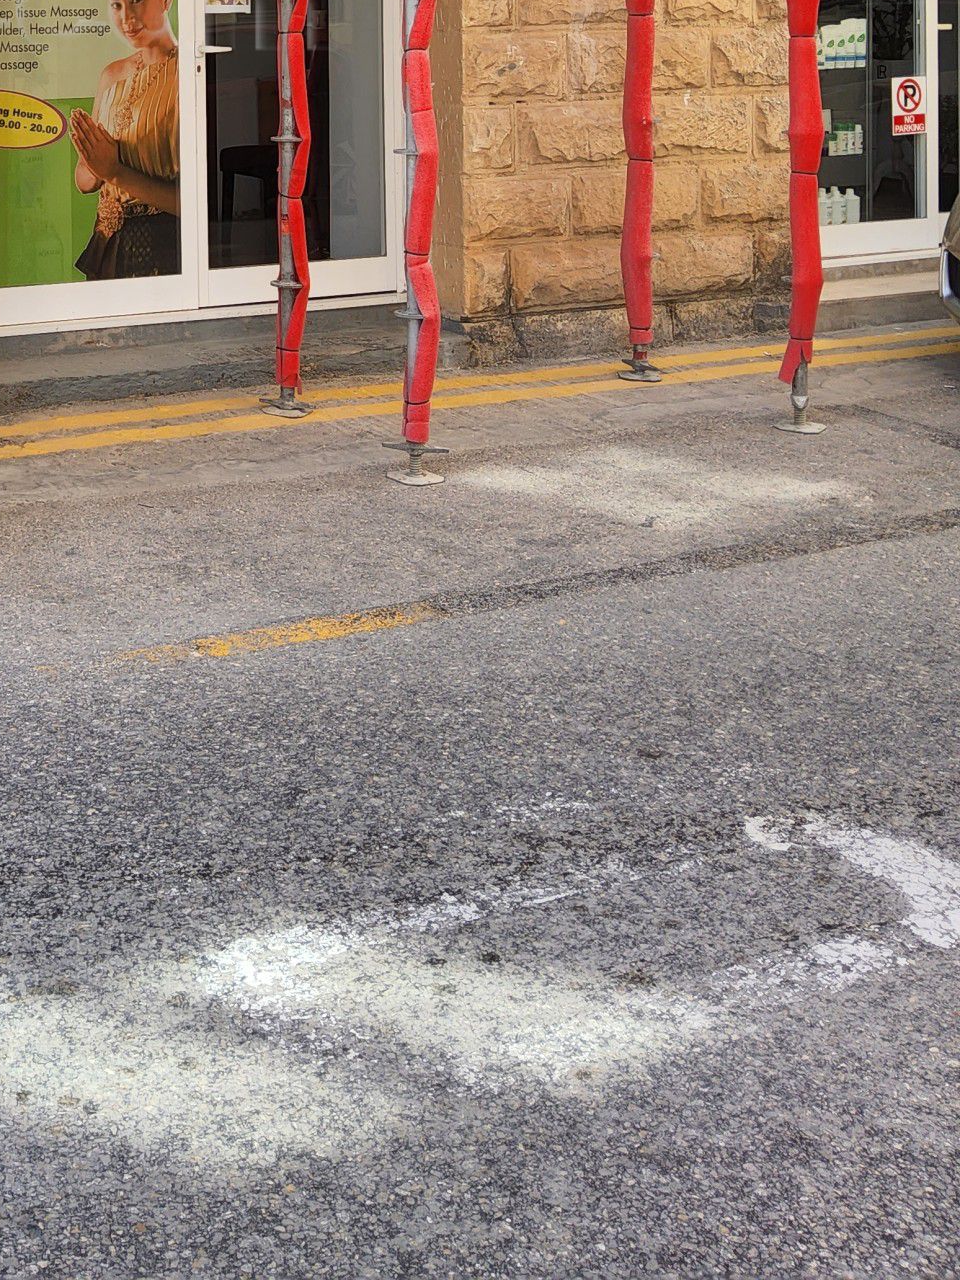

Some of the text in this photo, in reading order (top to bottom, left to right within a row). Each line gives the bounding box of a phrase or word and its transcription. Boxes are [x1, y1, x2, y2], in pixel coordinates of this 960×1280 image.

[17, 7, 47, 19] tissue
[50, 5, 99, 19] Massage
[30, 22, 59, 35] Head
[62, 21, 111, 37] Massage
[0, 41, 50, 56] Massage
[12, 107, 44, 121] Hours
[903, 115, 916, 124] NO
[0, 118, 21, 130] 9.00
[29, 122, 58, 135] 20.00
[894, 123, 925, 133] PARKING
